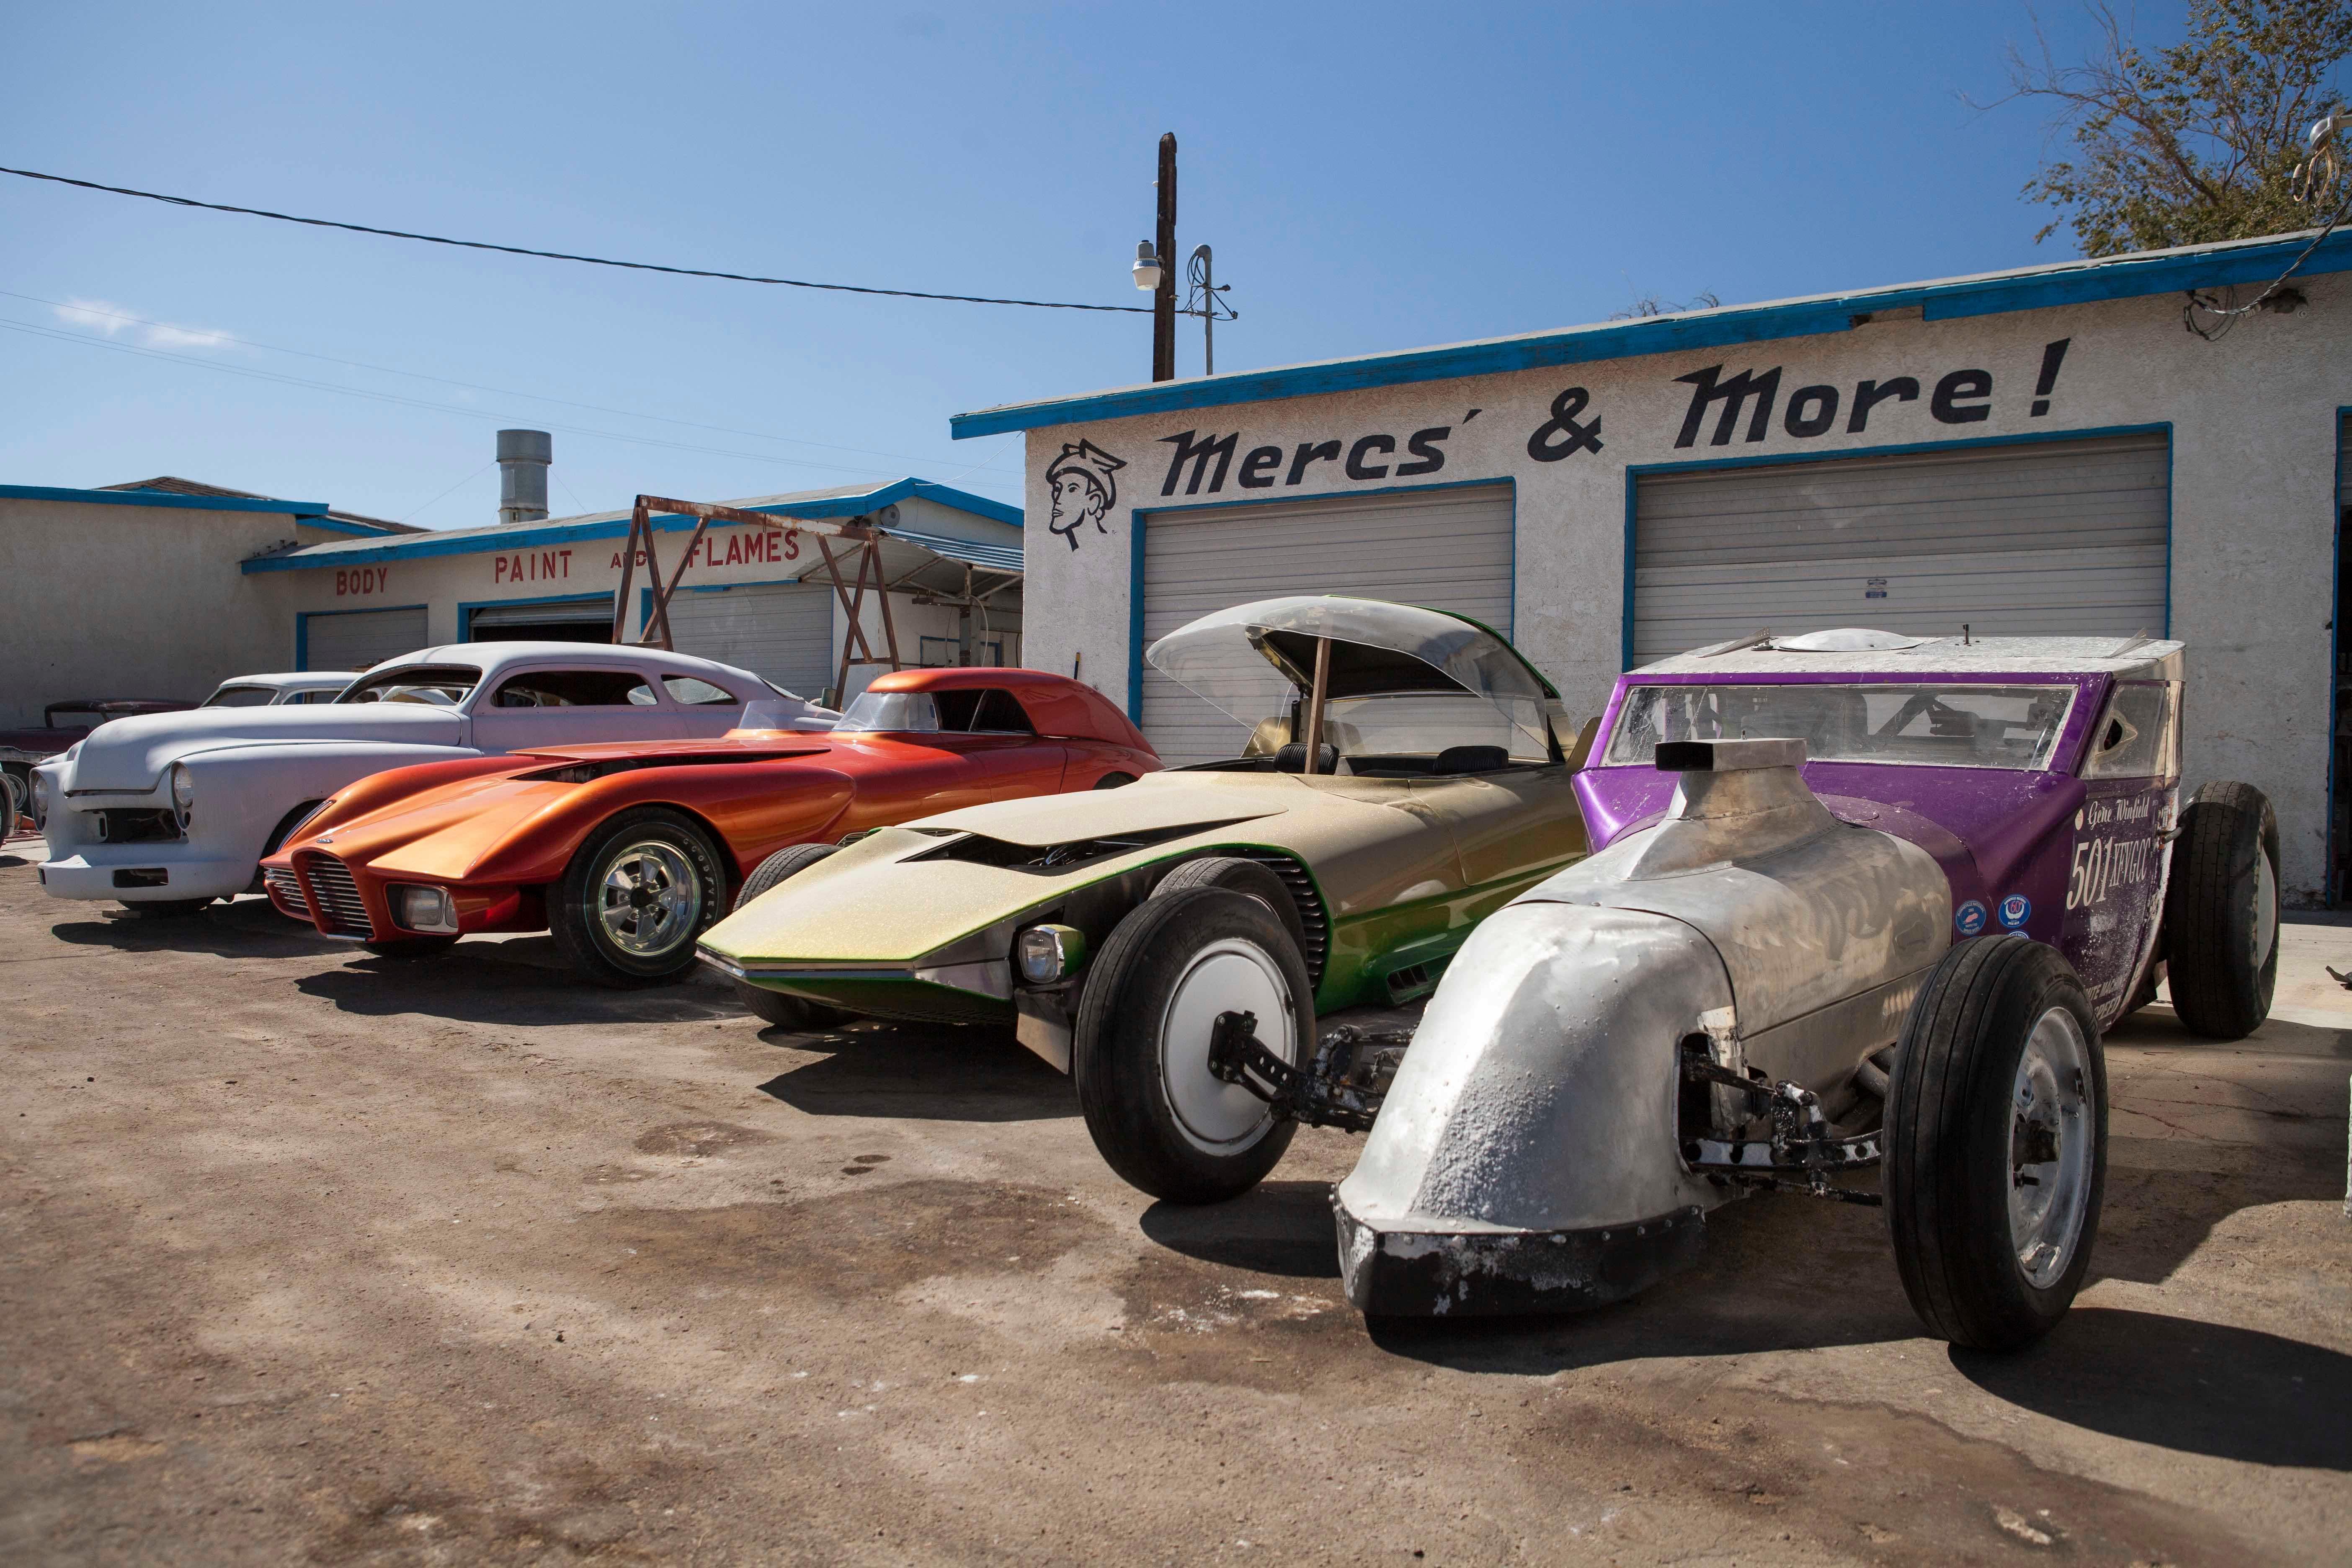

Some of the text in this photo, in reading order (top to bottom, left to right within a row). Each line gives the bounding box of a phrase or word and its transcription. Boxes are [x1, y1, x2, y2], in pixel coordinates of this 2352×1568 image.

[1155, 408, 1482, 497] Mercs'
[1527, 387, 1604, 462] &
[336, 567, 388, 596] BODY
[495, 529, 799, 584] PAINT AD FLAMES
[2087, 796, 2150, 830] Gene Winfield
[683, 838, 714, 932] GOODYEAR
[2066, 836, 2113, 910] 501
